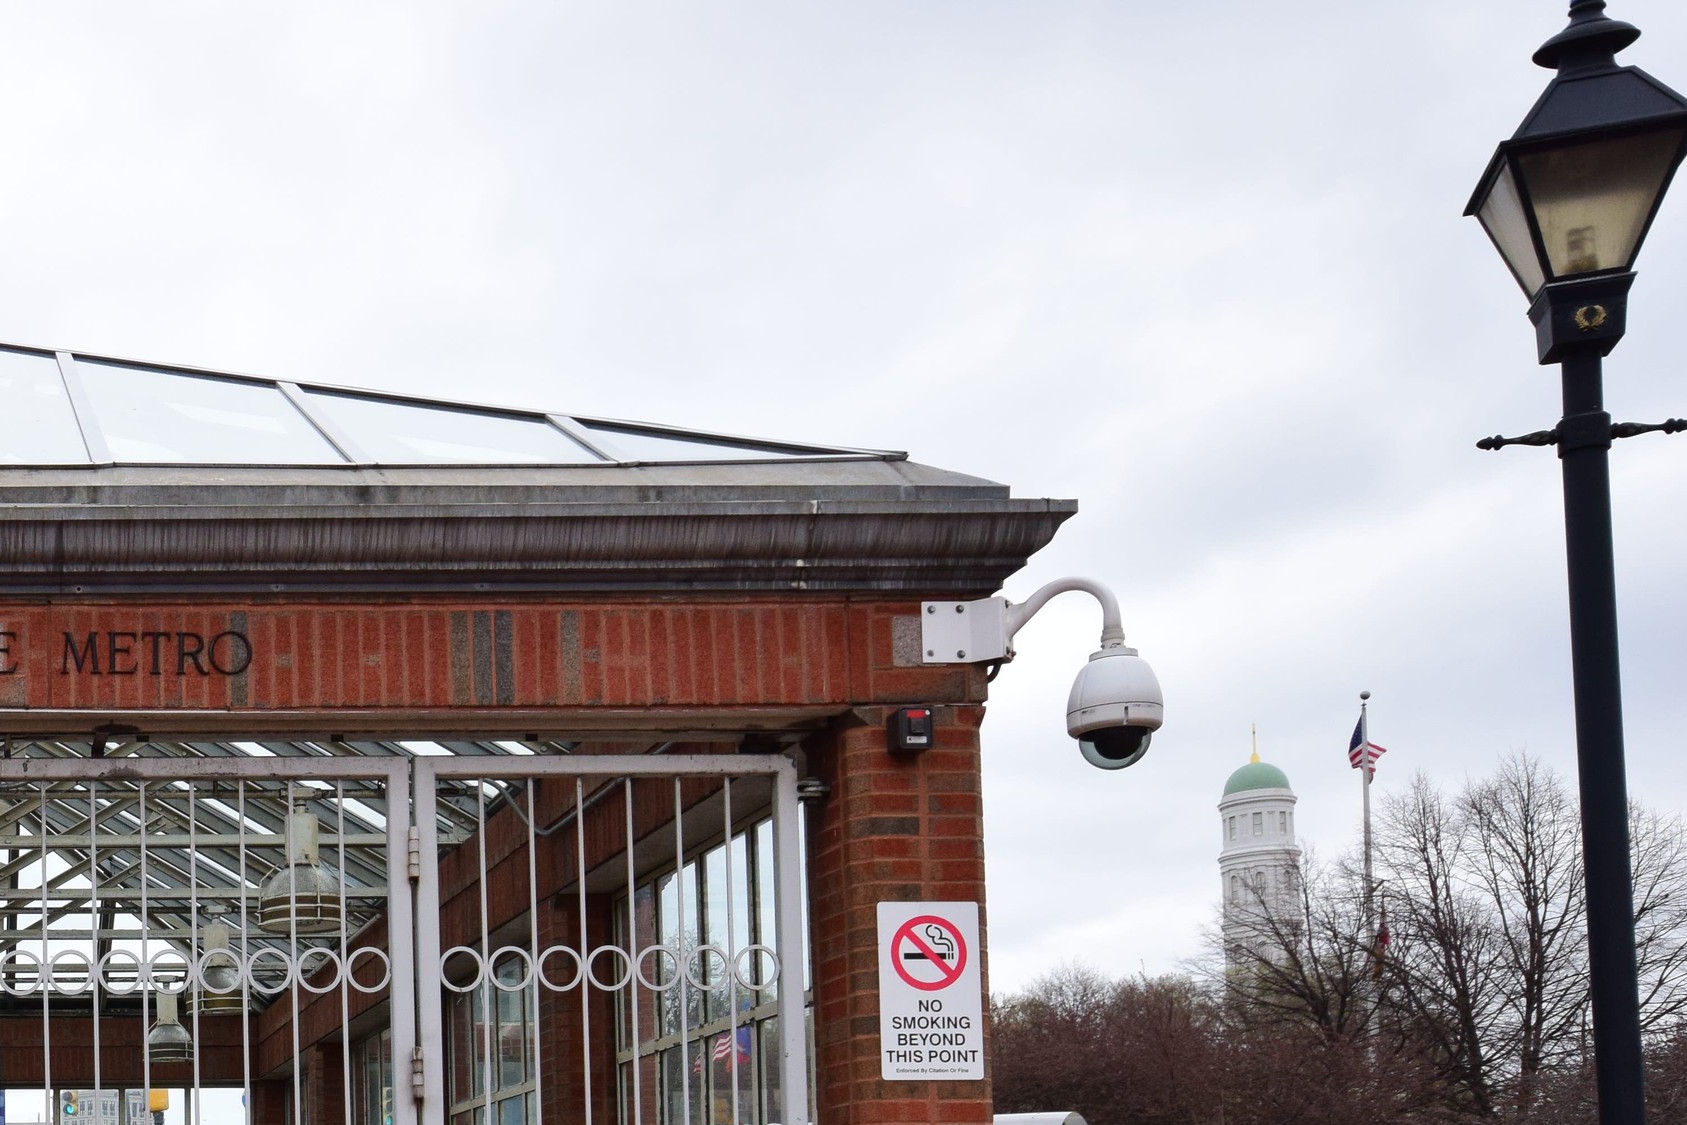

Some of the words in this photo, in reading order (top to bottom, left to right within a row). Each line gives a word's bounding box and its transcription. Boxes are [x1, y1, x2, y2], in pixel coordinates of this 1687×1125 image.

[60, 629, 254, 678] METRO
[918, 999, 943, 1013] NO
[892, 1016, 971, 1030] SMOKING
[897, 1033, 966, 1047] BEYOND
[885, 1049, 924, 1063] THIS
[928, 1049, 979, 1063] POINT
